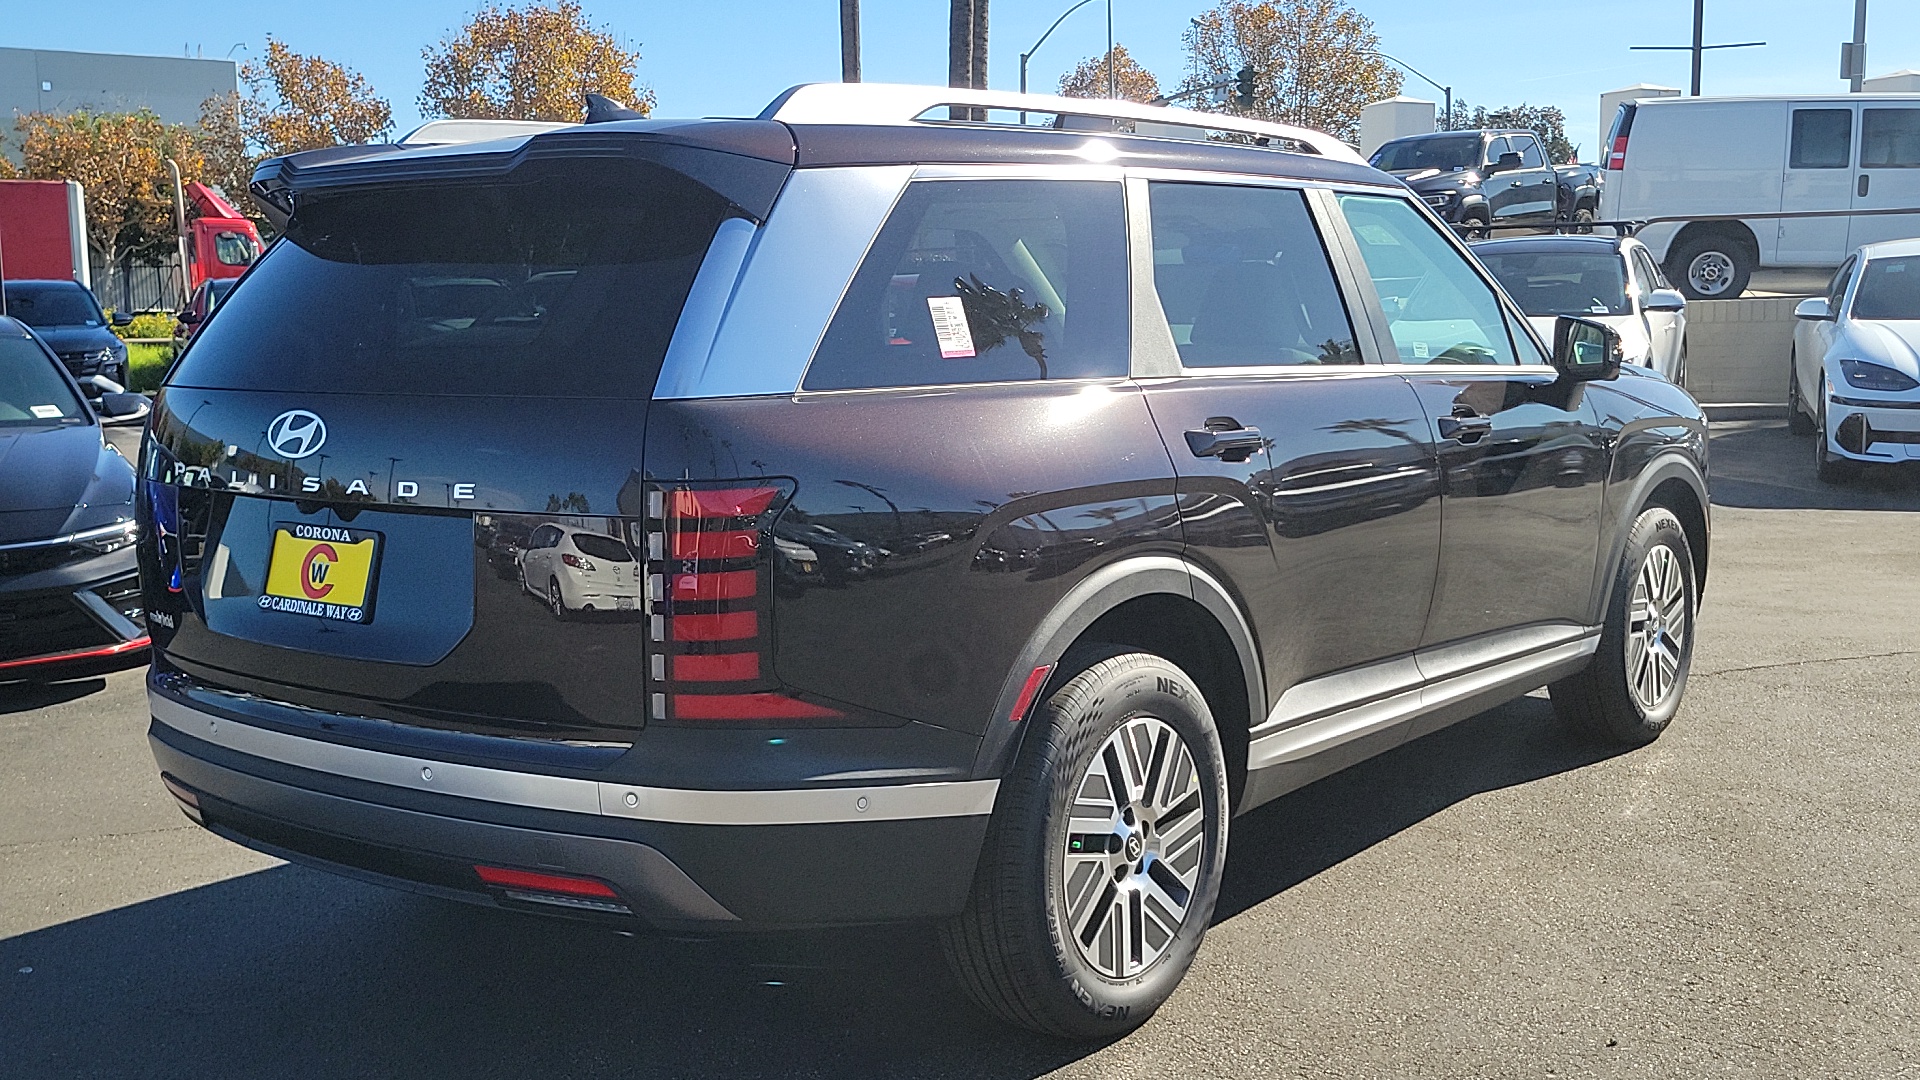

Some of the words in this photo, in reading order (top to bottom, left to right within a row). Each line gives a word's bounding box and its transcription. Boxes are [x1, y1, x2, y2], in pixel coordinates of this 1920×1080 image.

[174, 461, 477, 499] PALISADE
[295, 524, 351, 542] CORONA
[301, 543, 339, 600] C
[312, 562, 330, 584] W
[271, 597, 325, 616] CARDINALE
[326, 605, 349, 620] WAY
